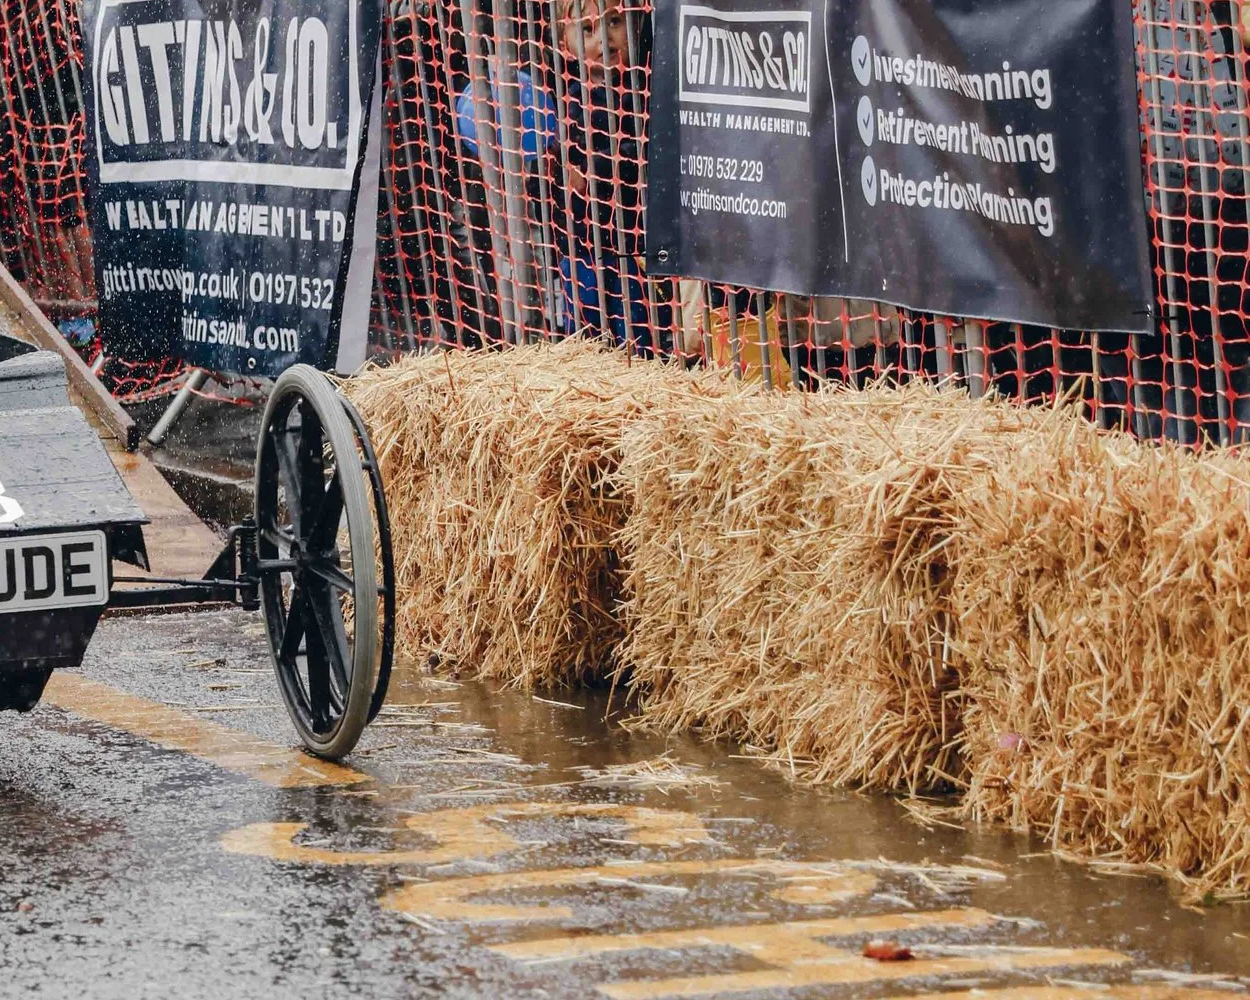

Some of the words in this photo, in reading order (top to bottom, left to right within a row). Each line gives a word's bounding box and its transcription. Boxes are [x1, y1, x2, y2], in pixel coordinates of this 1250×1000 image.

[679, 110, 721, 127] WEALTH
[726, 114, 795, 135] MANAGEMENT
[877, 107, 968, 153] Retirement
[688, 154, 714, 179] 01978
[716, 157, 737, 181] 532
[739, 160, 764, 183] 229
[880, 169, 975, 211] Protection
[301, 276, 335, 310] 532
